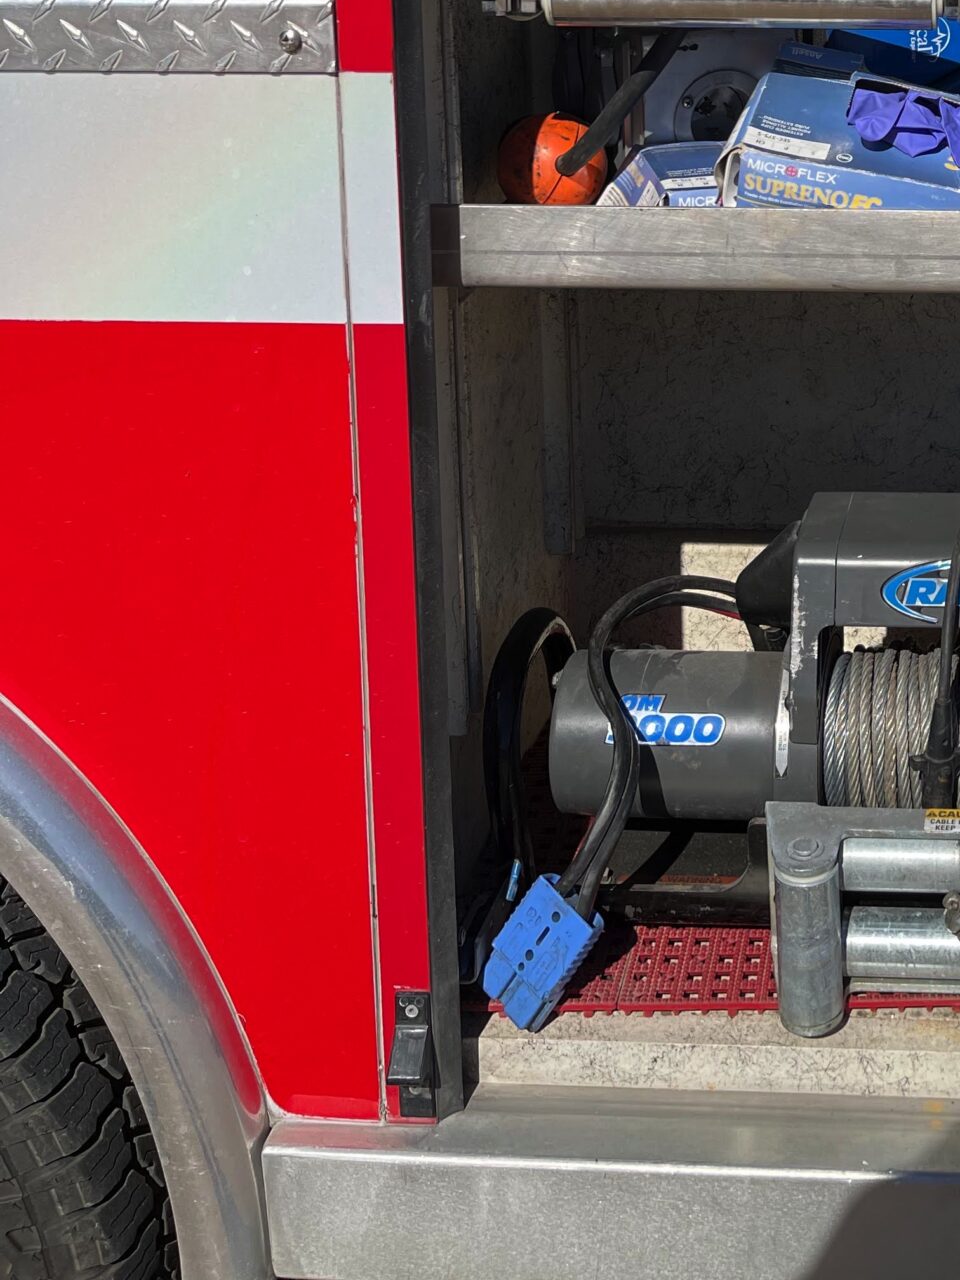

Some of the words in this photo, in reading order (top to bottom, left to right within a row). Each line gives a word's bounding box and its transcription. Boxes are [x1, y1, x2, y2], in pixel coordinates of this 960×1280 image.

[746, 158, 838, 184] MICROFLEX
[744, 174, 849, 208] SUPRENO
[606, 714, 724, 743] 000
